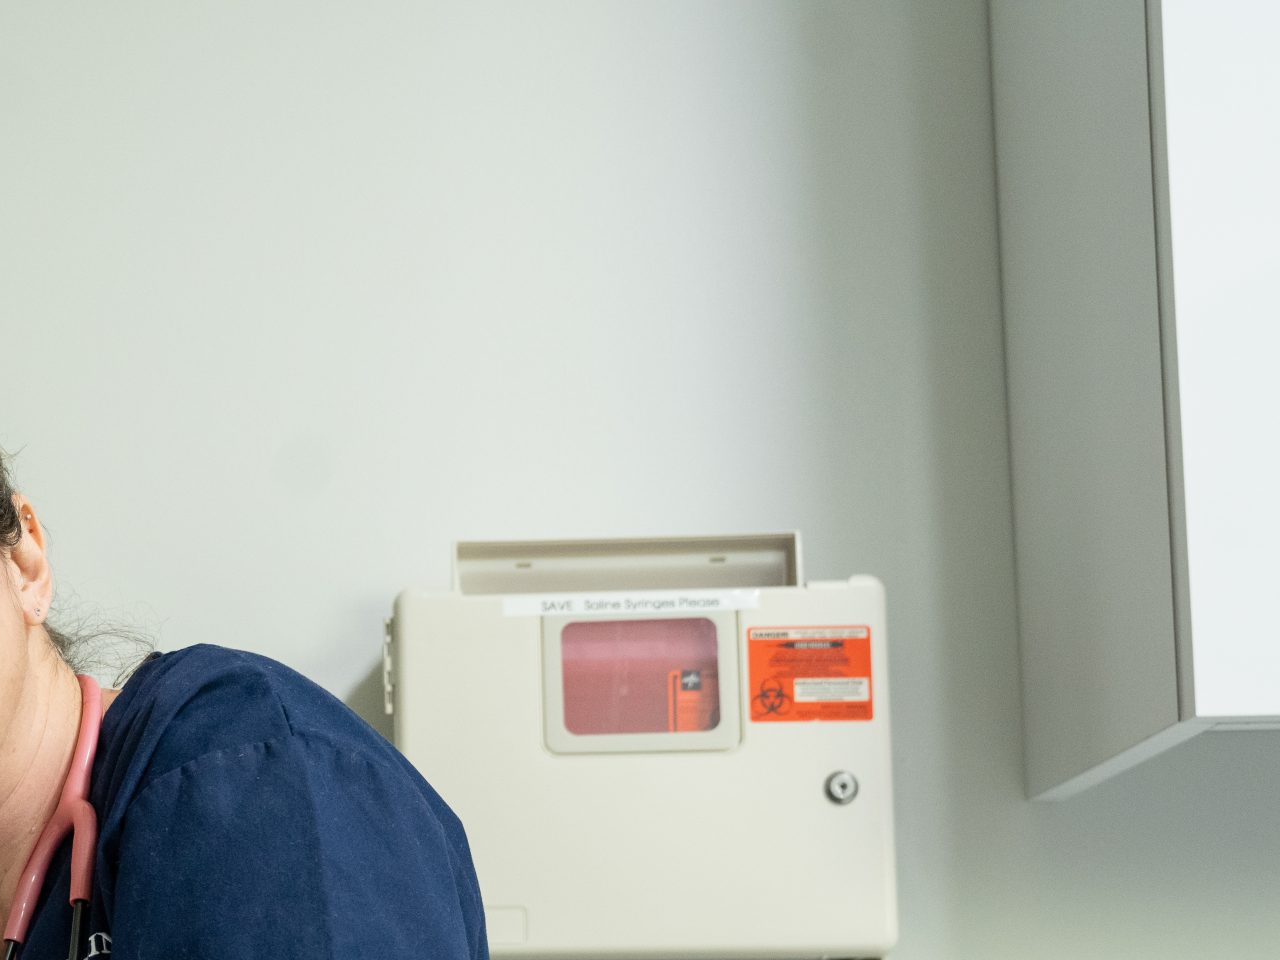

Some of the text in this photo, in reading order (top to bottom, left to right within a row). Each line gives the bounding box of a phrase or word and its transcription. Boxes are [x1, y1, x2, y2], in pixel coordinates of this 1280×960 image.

[541, 597, 719, 612] SAVE Saline Syringes Please
